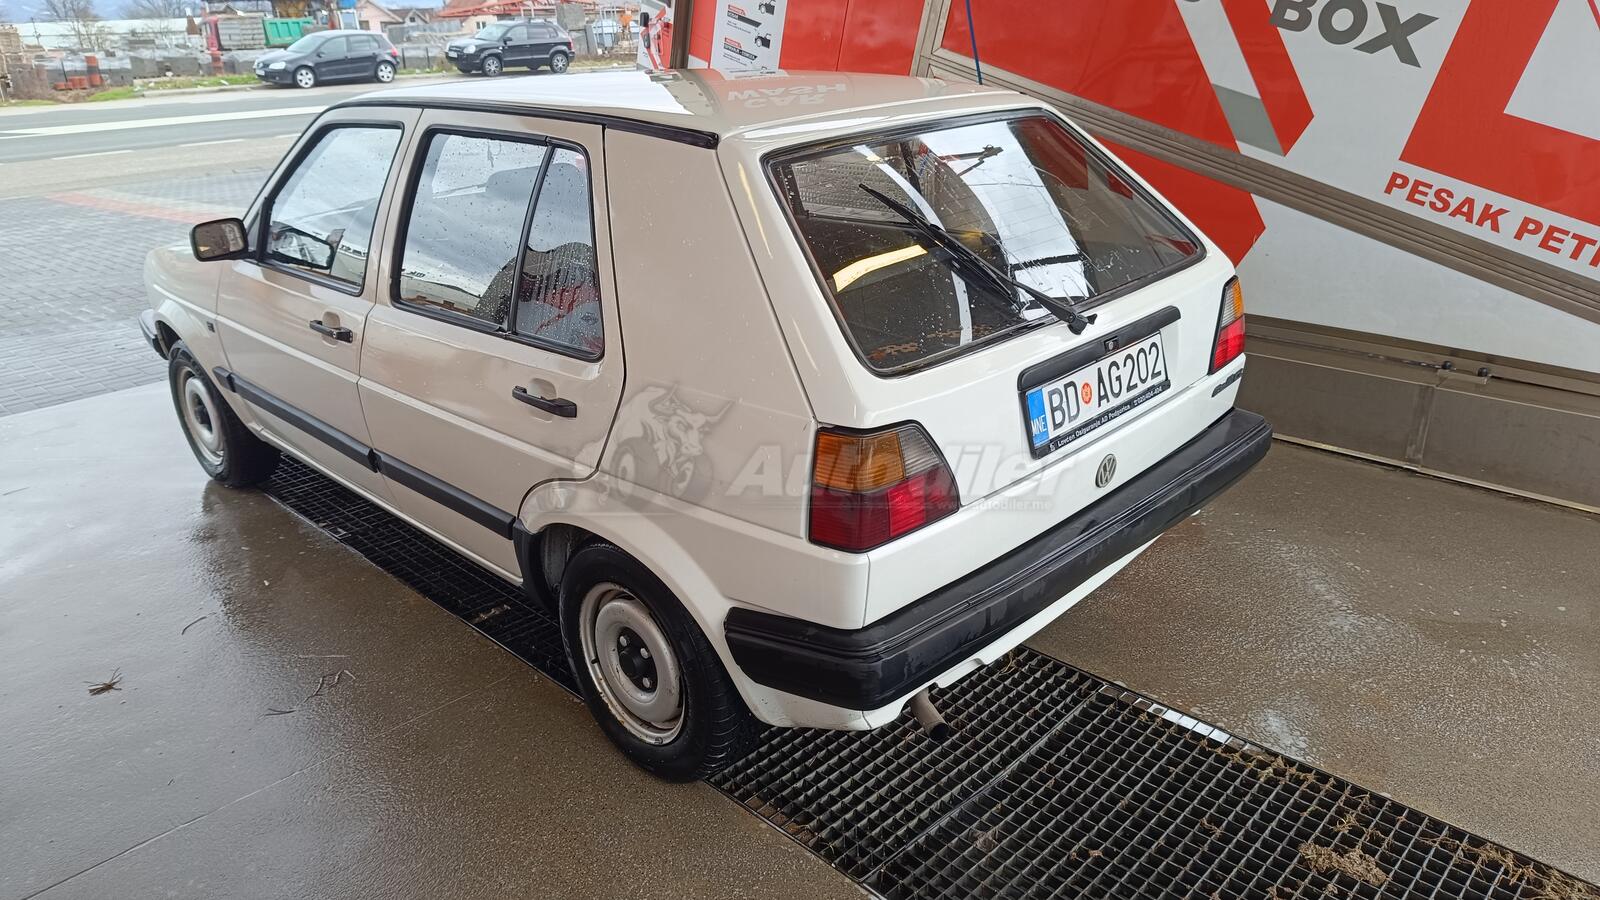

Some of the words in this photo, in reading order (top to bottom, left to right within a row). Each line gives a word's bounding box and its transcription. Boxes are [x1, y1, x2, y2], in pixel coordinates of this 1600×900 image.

[1269, 0, 1440, 68] BOX
[1384, 171, 1510, 233] PESAK
[1048, 381, 1080, 431] BD
[1097, 342, 1162, 408] AG202
[1031, 414, 1047, 436] MNE
